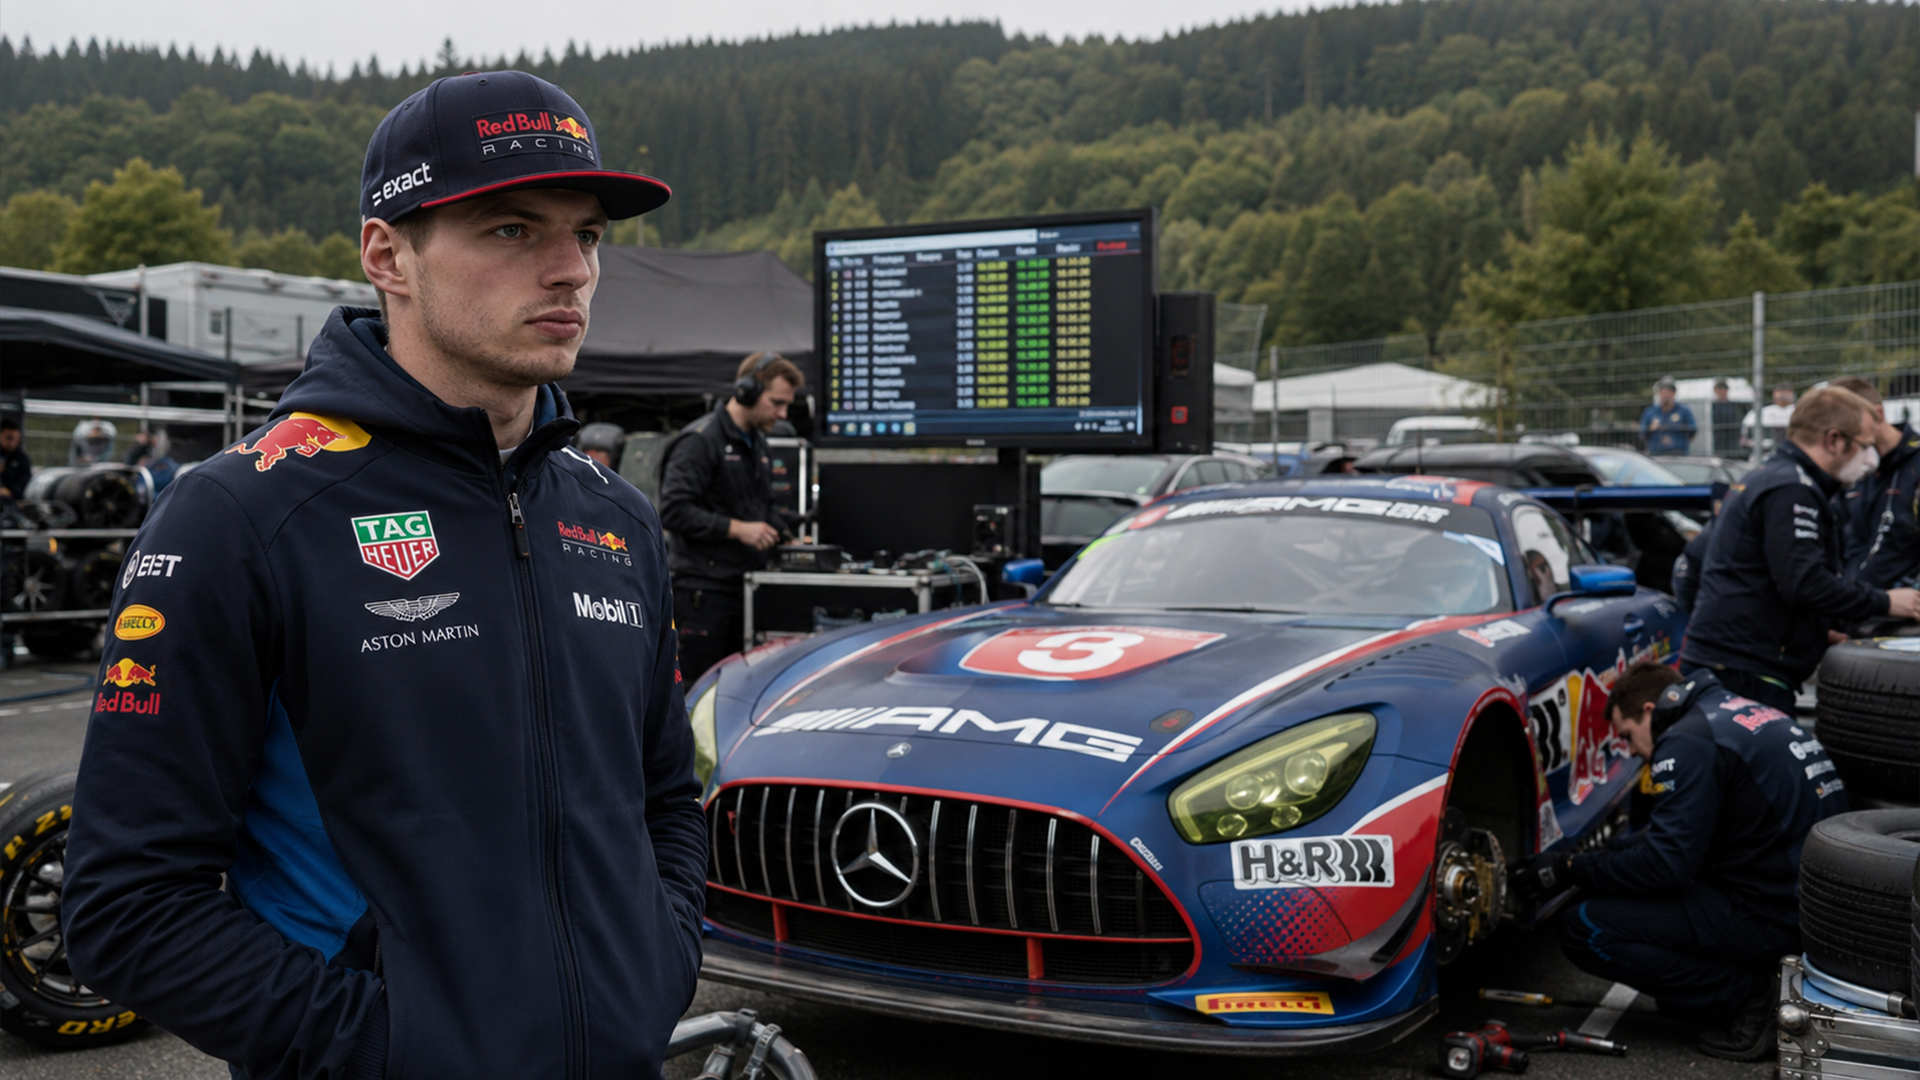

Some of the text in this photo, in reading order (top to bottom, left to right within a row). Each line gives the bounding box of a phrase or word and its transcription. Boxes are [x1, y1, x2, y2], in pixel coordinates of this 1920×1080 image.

[476, 111, 552, 138] Red Bull
[382, 161, 432, 200] exact
[358, 516, 427, 541] TAG
[557, 521, 598, 545] Red Bull
[364, 540, 436, 575] HEUER
[562, 543, 633, 567] RACING
[572, 592, 627, 625] Mobil
[360, 624, 480, 653] ASTON MARTIN
[1017, 631, 1145, 673] 3
[119, 692, 161, 715] Bull
[1239, 840, 1339, 882] H&R
[1207, 995, 1321, 1010] PIRELLI
[57, 1009, 137, 1035] ERO
